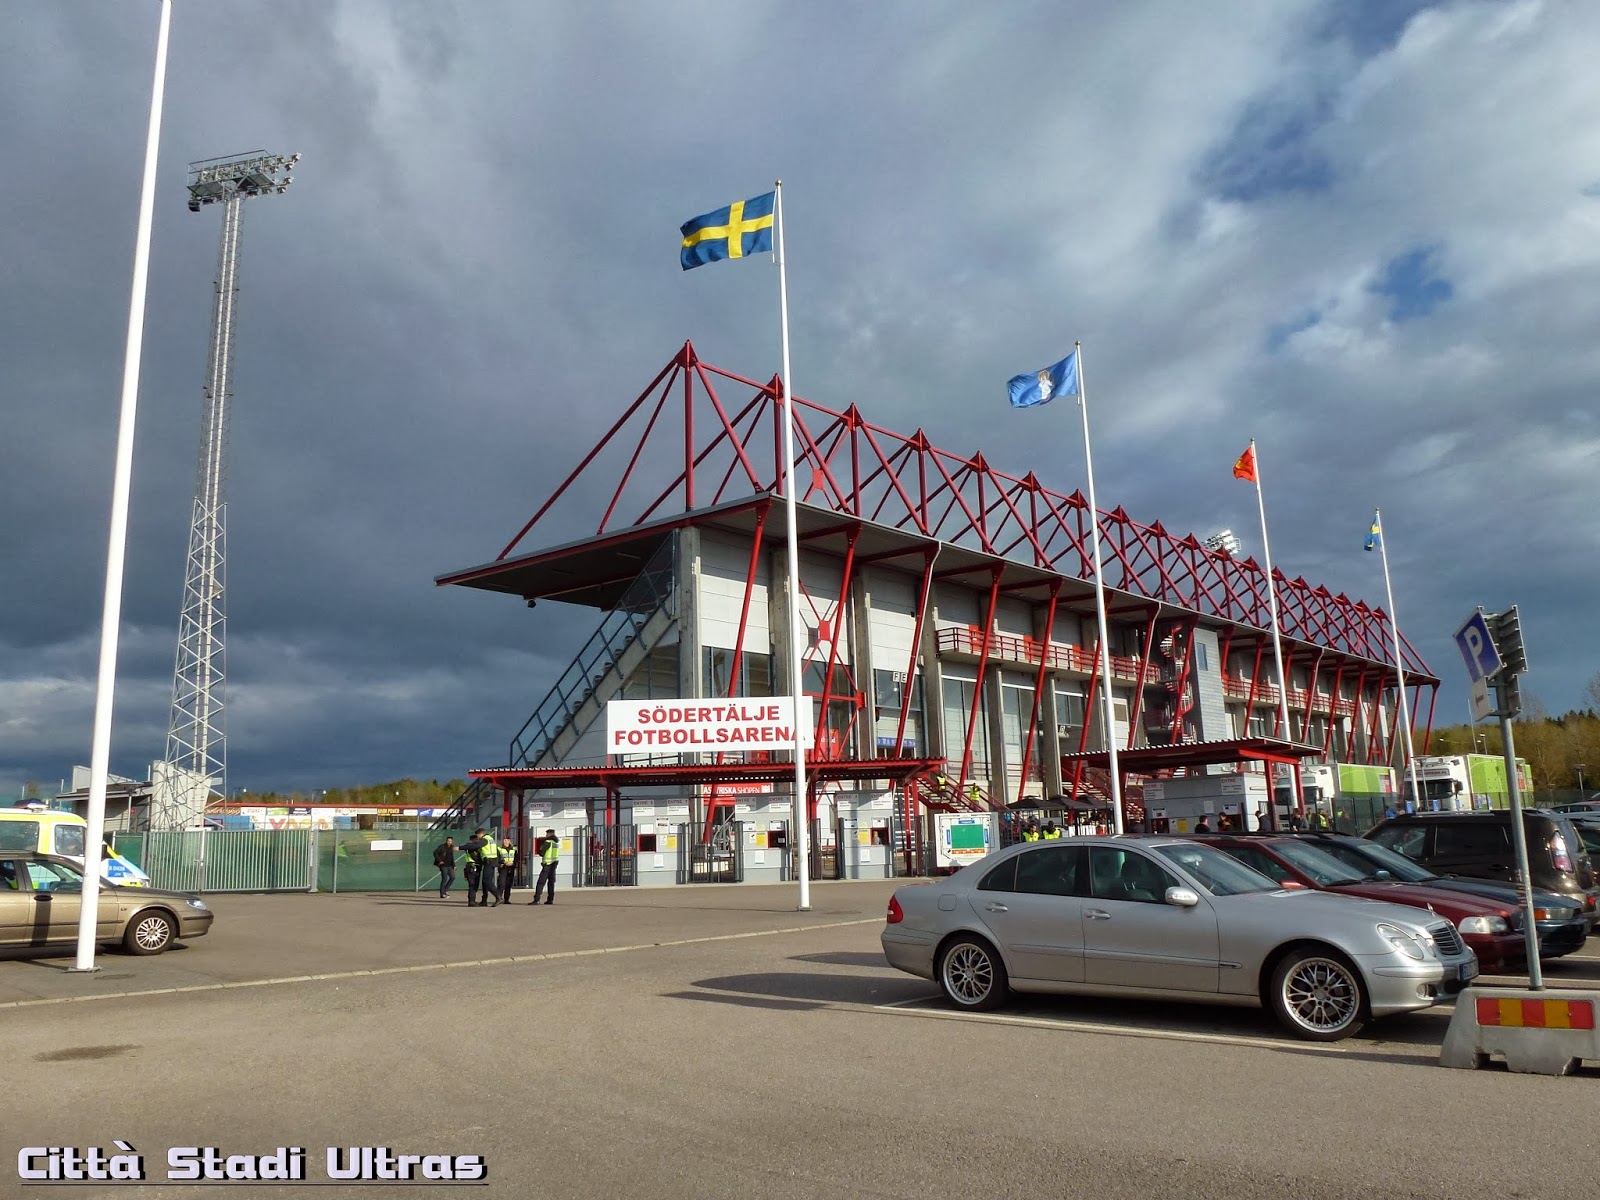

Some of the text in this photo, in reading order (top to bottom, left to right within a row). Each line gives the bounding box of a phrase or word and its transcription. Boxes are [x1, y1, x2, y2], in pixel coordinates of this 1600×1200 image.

[1463, 625, 1484, 677] P
[637, 703, 780, 724] SÖDERTÄLJE
[703, 786, 737, 794] ASRISKA
